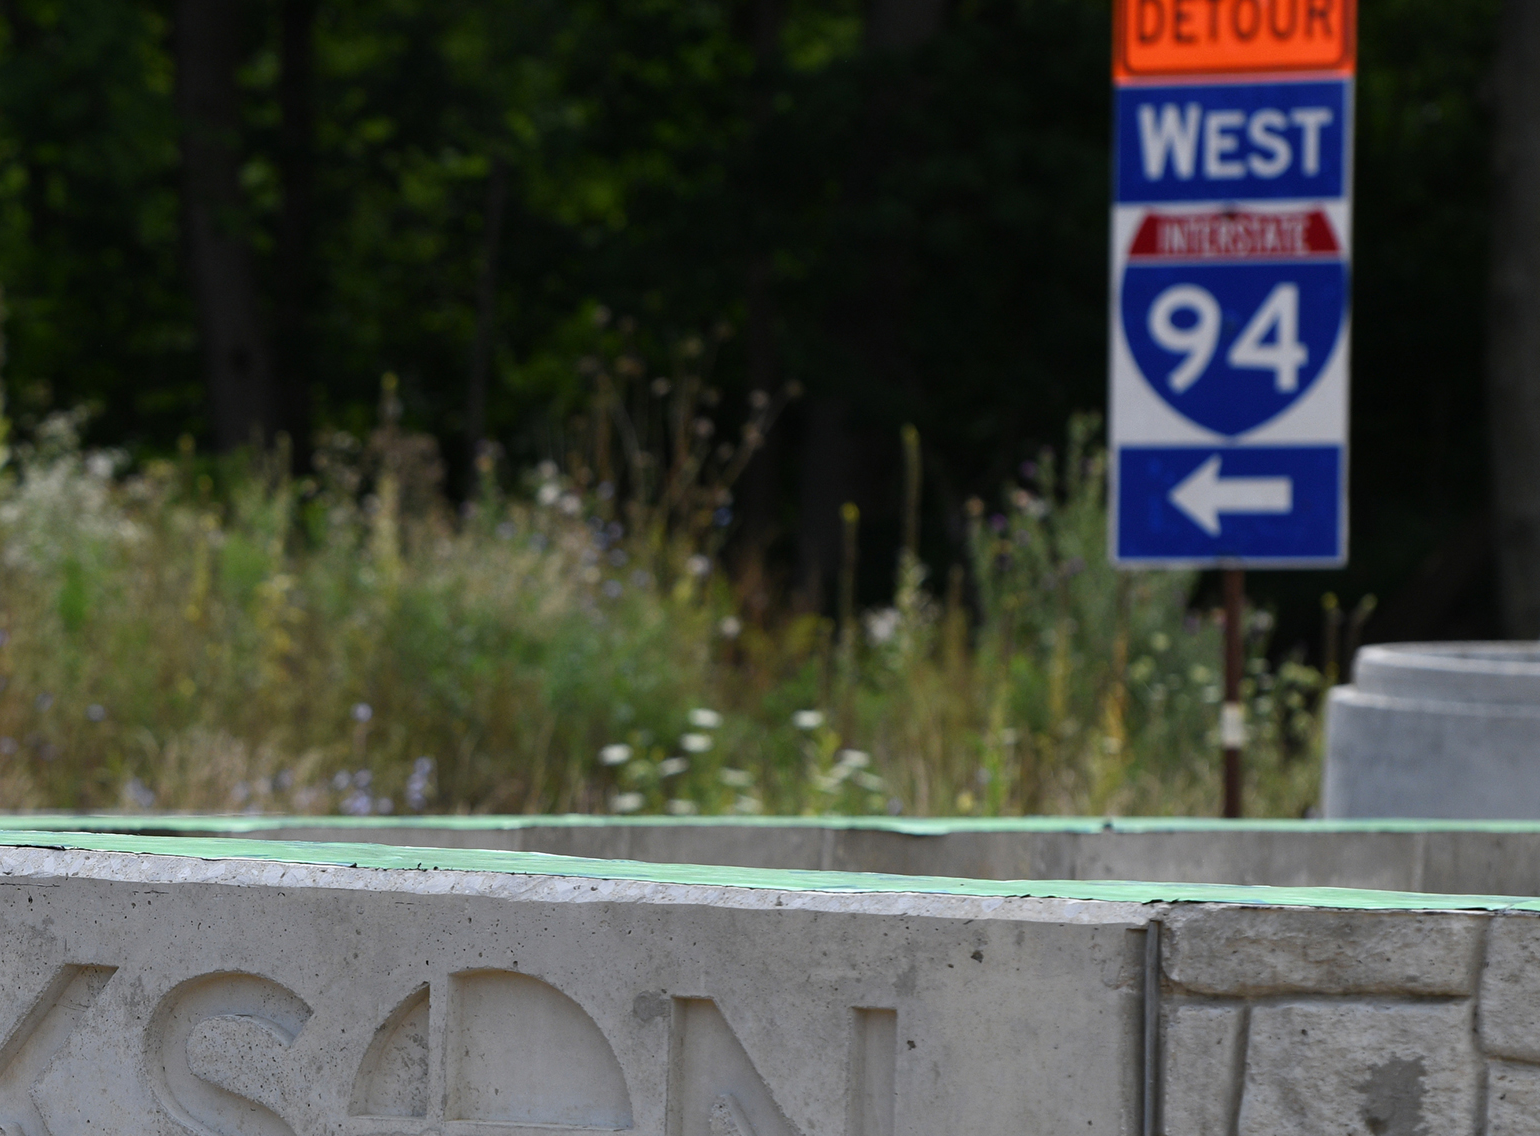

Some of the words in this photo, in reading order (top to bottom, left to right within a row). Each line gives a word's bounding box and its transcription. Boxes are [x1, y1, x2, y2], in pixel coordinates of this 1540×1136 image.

[1137, 0, 1334, 44] DETOUR
[1137, 102, 1334, 181] WEST
[1160, 213, 1309, 257] INTERSTATE
[1146, 282, 1308, 394] 94
